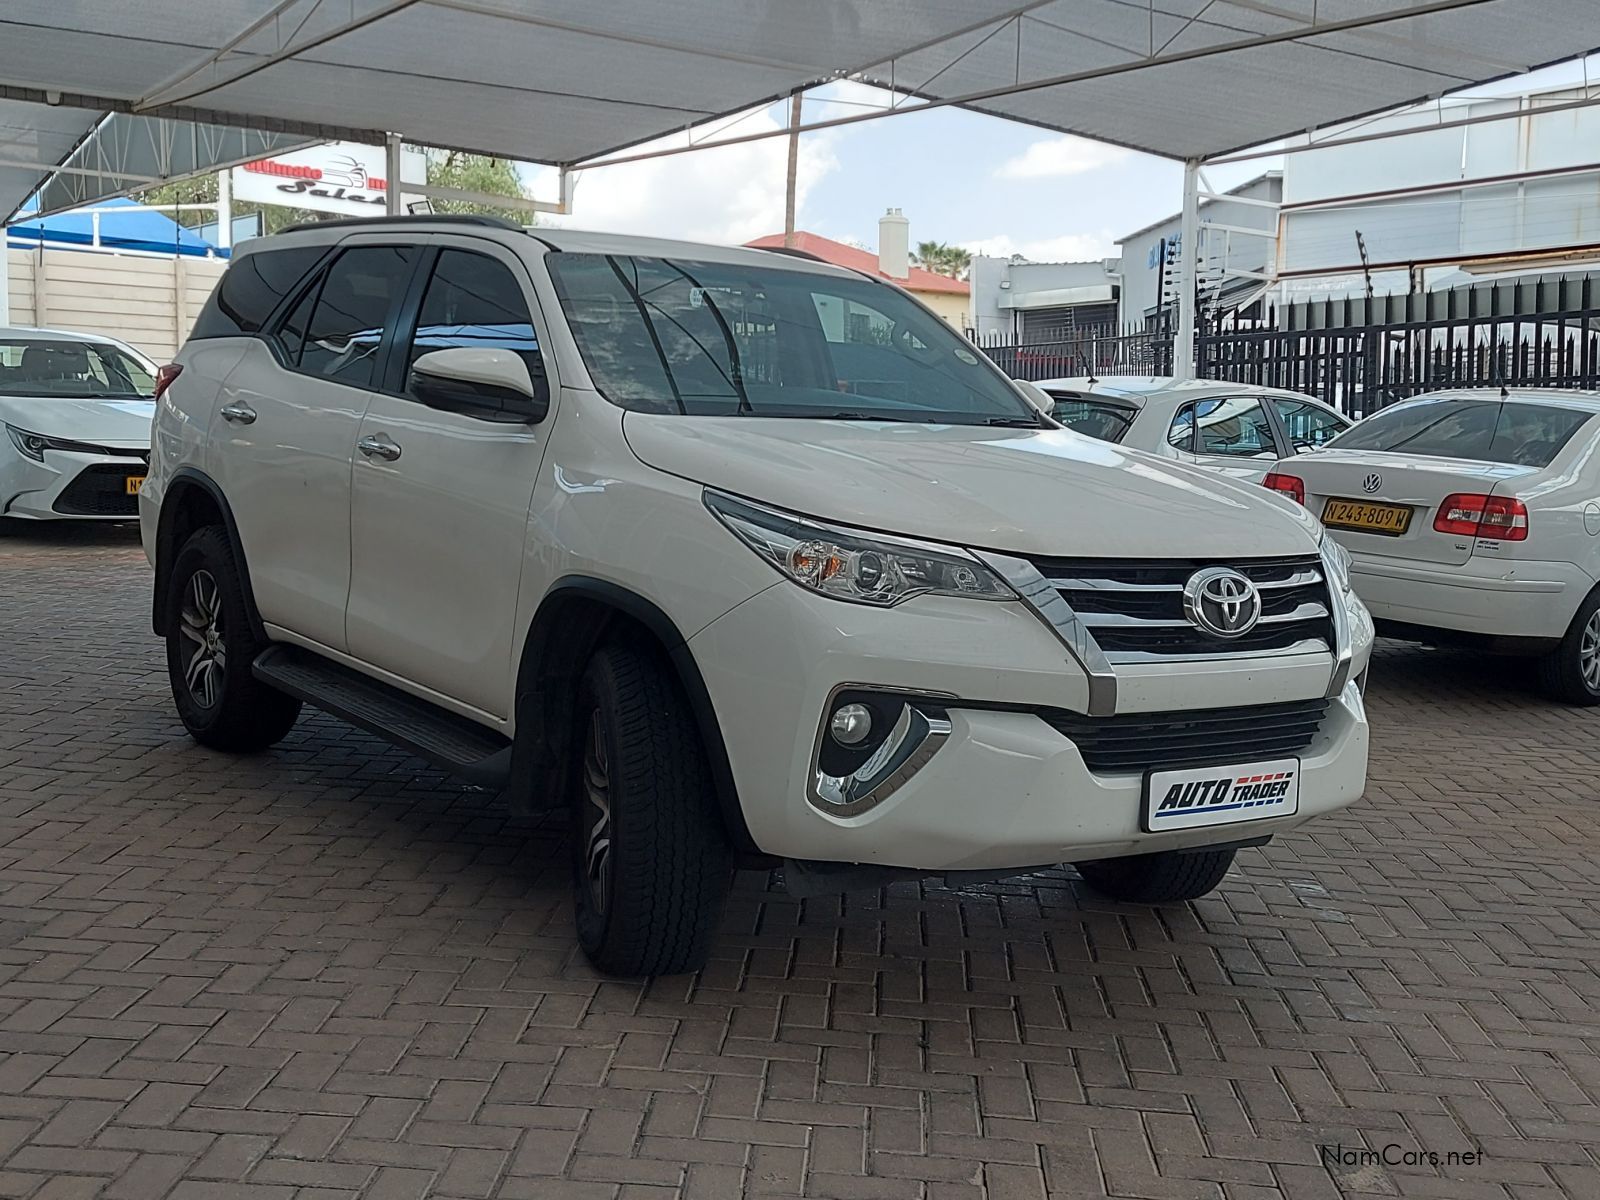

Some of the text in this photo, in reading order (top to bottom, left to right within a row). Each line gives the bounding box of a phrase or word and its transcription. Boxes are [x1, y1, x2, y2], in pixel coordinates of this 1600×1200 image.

[276, 181, 387, 206] Sales
[1158, 779, 1291, 810] AUTO TRADER
